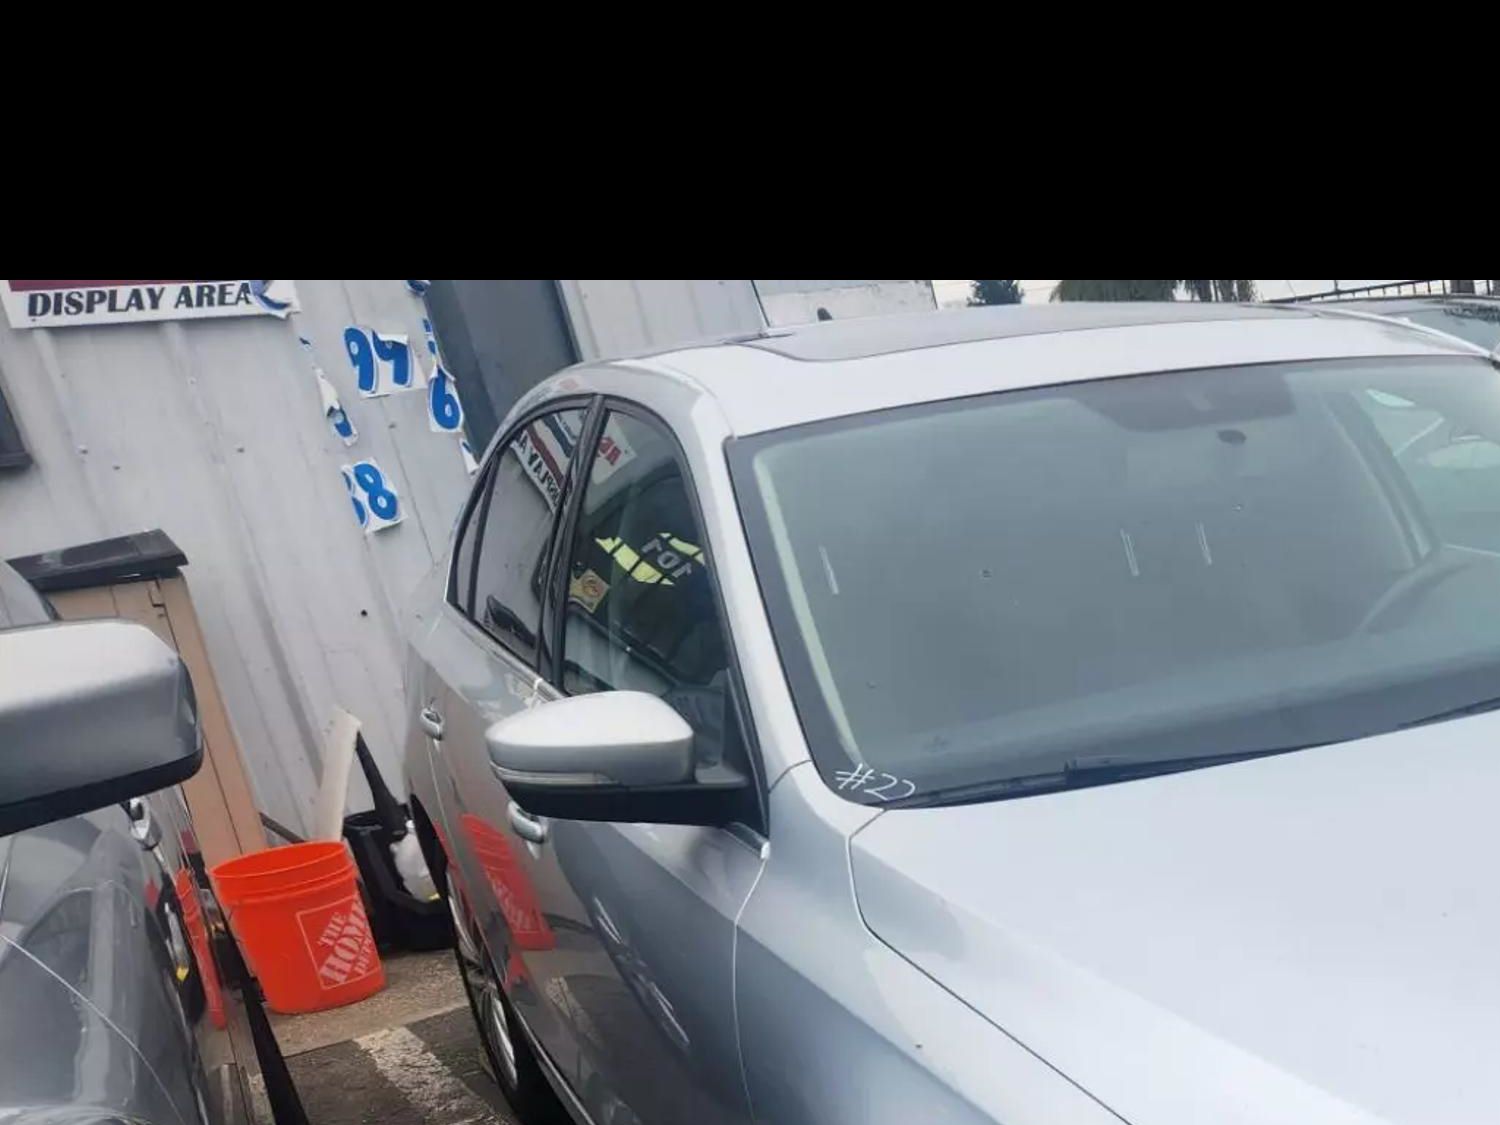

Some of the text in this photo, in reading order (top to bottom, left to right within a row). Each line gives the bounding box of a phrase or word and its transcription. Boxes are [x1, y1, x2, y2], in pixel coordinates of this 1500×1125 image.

[27, 286, 166, 317] DISPLAY
[174, 282, 252, 309] AREA
[316, 911, 347, 947] THE
